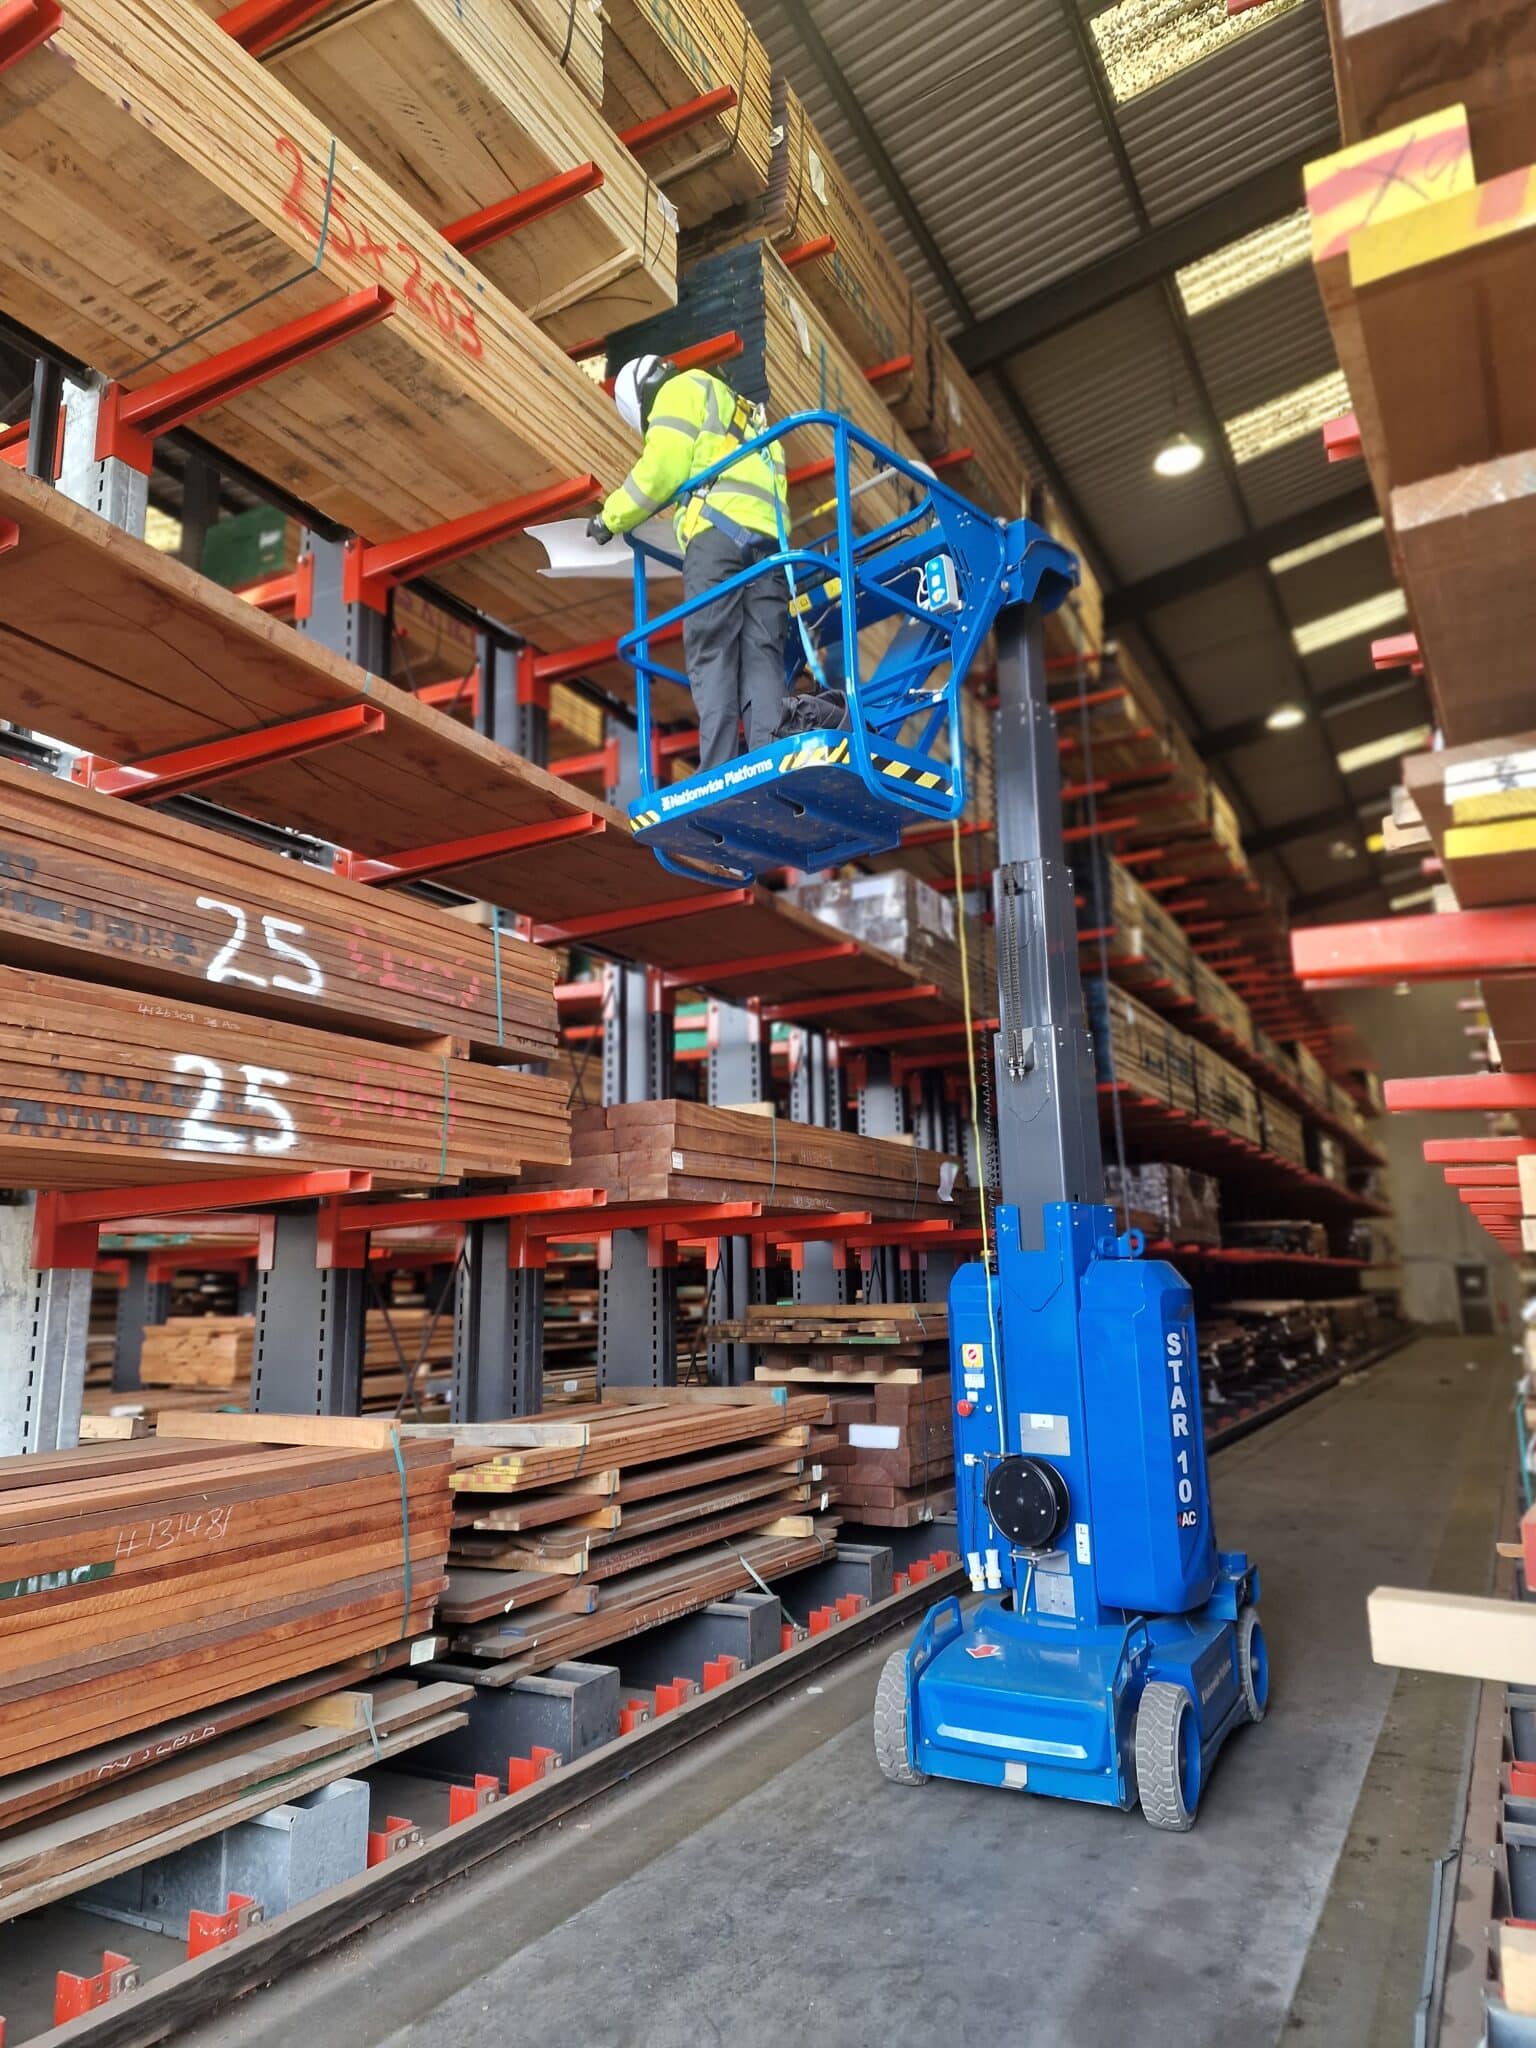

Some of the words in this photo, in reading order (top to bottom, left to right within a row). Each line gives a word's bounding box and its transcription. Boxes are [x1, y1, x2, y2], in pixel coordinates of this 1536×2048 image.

[668, 779, 725, 807] Nationwide
[724, 759, 774, 786] Platforms
[195, 896, 325, 996] 25
[172, 1054, 300, 1154] 25
[1166, 1332, 1190, 1438] STAR
[1176, 1449, 1193, 1504] 10
[1181, 1511, 1198, 1528] AC
